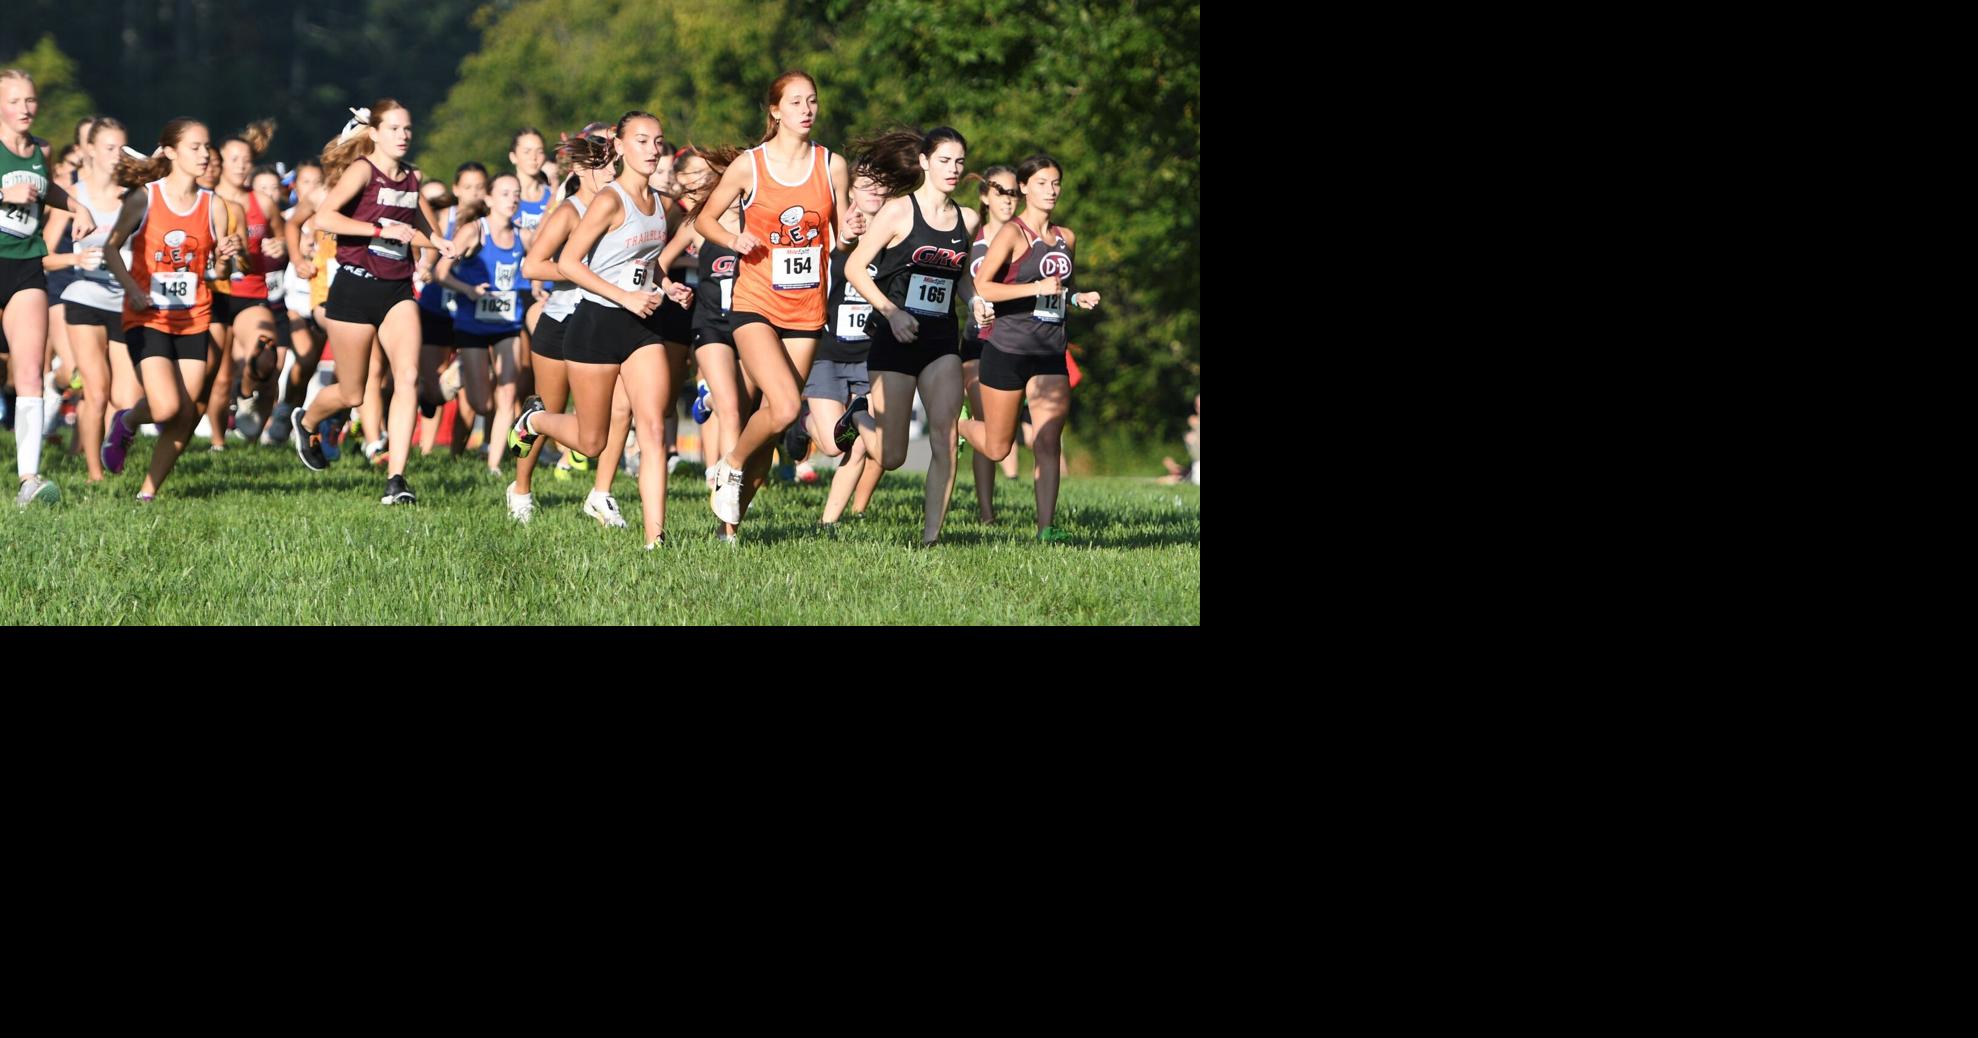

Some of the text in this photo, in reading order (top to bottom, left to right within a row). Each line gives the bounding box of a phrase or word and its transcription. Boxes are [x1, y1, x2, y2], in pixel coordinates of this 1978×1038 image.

[790, 227, 804, 242] E
[171, 250, 182, 262] E
[784, 257, 812, 275] 154
[159, 281, 188, 297] 148
[919, 284, 947, 304] 165
[480, 299, 511, 312] 1025
[848, 313, 867, 328] 16
